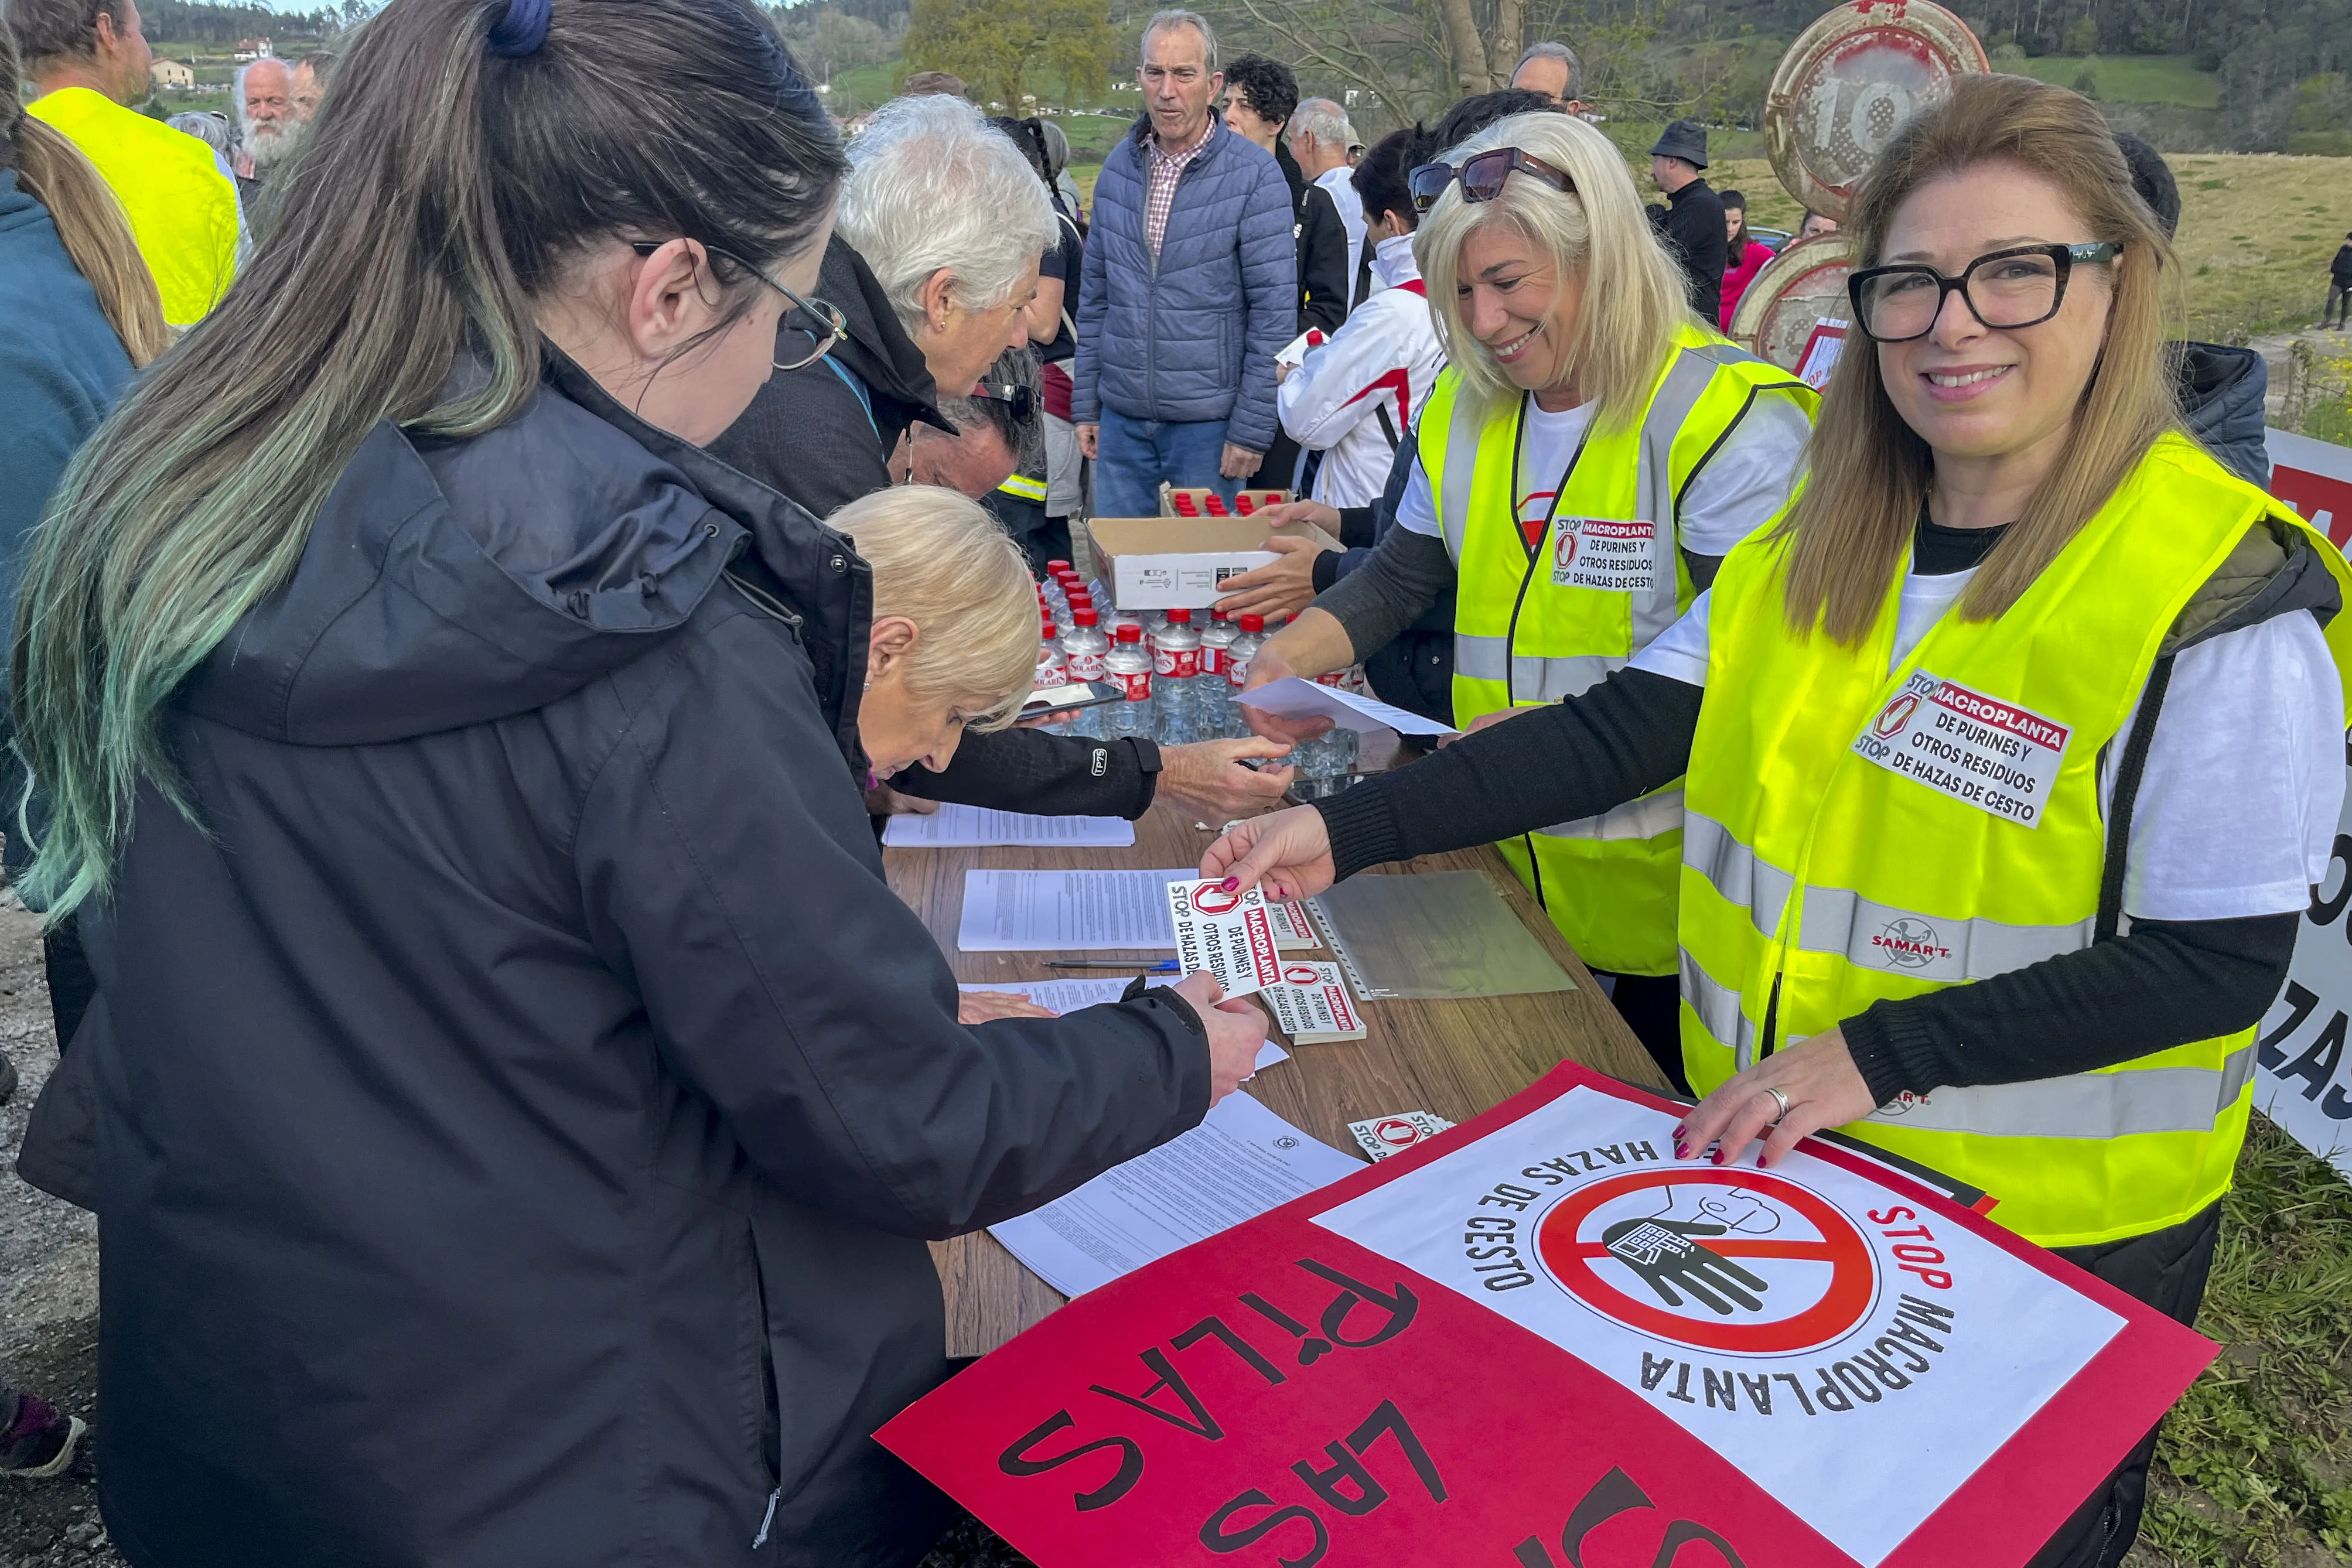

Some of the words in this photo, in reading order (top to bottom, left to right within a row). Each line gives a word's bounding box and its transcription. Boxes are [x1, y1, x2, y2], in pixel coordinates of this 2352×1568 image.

[1808, 77, 1911, 154] 10
[1558, 519, 1581, 531] STOP
[1583, 523, 1654, 537] MACROPLANTA
[1590, 539, 1600, 551] DE
[1601, 541, 1637, 553] PURINES
[1639, 541, 1646, 553] Y
[1579, 556, 1607, 569] OTROS
[1609, 559, 1653, 571] RESIDUOS
[1553, 571, 1570, 583] STOP
[1573, 572, 1584, 584] DE
[1586, 574, 1613, 587] HAZAS
[1615, 577, 1627, 588] DE
[1629, 577, 1654, 589] CESTO
[1071, 660, 1105, 673] SOLARES
[1931, 684, 2063, 749] MACROPLANTA
[1855, 735, 1890, 760] STOP
[1935, 712, 1954, 730] DE
[1955, 720, 2019, 758] PURINES
[2020, 745, 2032, 762] Y
[1911, 732, 1962, 764] OTROS
[1961, 751, 2036, 794] RESIDUOS
[1892, 751, 1912, 773] DE
[1912, 758, 1962, 793] HAZAS
[1961, 781, 1985, 802] DE
[1985, 790, 2035, 821] CESTO
[1172, 886, 1192, 918] STOP
[1178, 921, 1194, 933] DE
[1203, 923, 1222, 952] OTROS
[1227, 926, 1243, 938] DE
[1180, 933, 1200, 962] HAZAS
[1231, 938, 1252, 974] PURINES
[1248, 910, 1276, 986] MACROPLANTA
[1872, 935, 1950, 957] SAMAR'T
[1319, 967, 1336, 985] STOP
[1274, 993, 1291, 1009] HAZAS
[1291, 989, 1308, 1006] OTROS
[1313, 1000, 1331, 1020] PURINES
[1325, 986, 1352, 1031] MACROPLANTA
[1282, 1016, 1298, 1032] CESTO
[1296, 1006, 1316, 1029] RESIDUOS
[1354, 1125, 1381, 1149] STOP
[1521, 1140, 1660, 1185] HAZAS
[1477, 1183, 1542, 1211] DE
[1464, 1217, 1535, 1292] CESTO
[1866, 1205, 1953, 1290] STOP
[1640, 1293, 1955, 1416] MACROPLANTA
[998, 1258, 1419, 1512] PILAS
[1198, 1399, 1449, 1568] LAS
